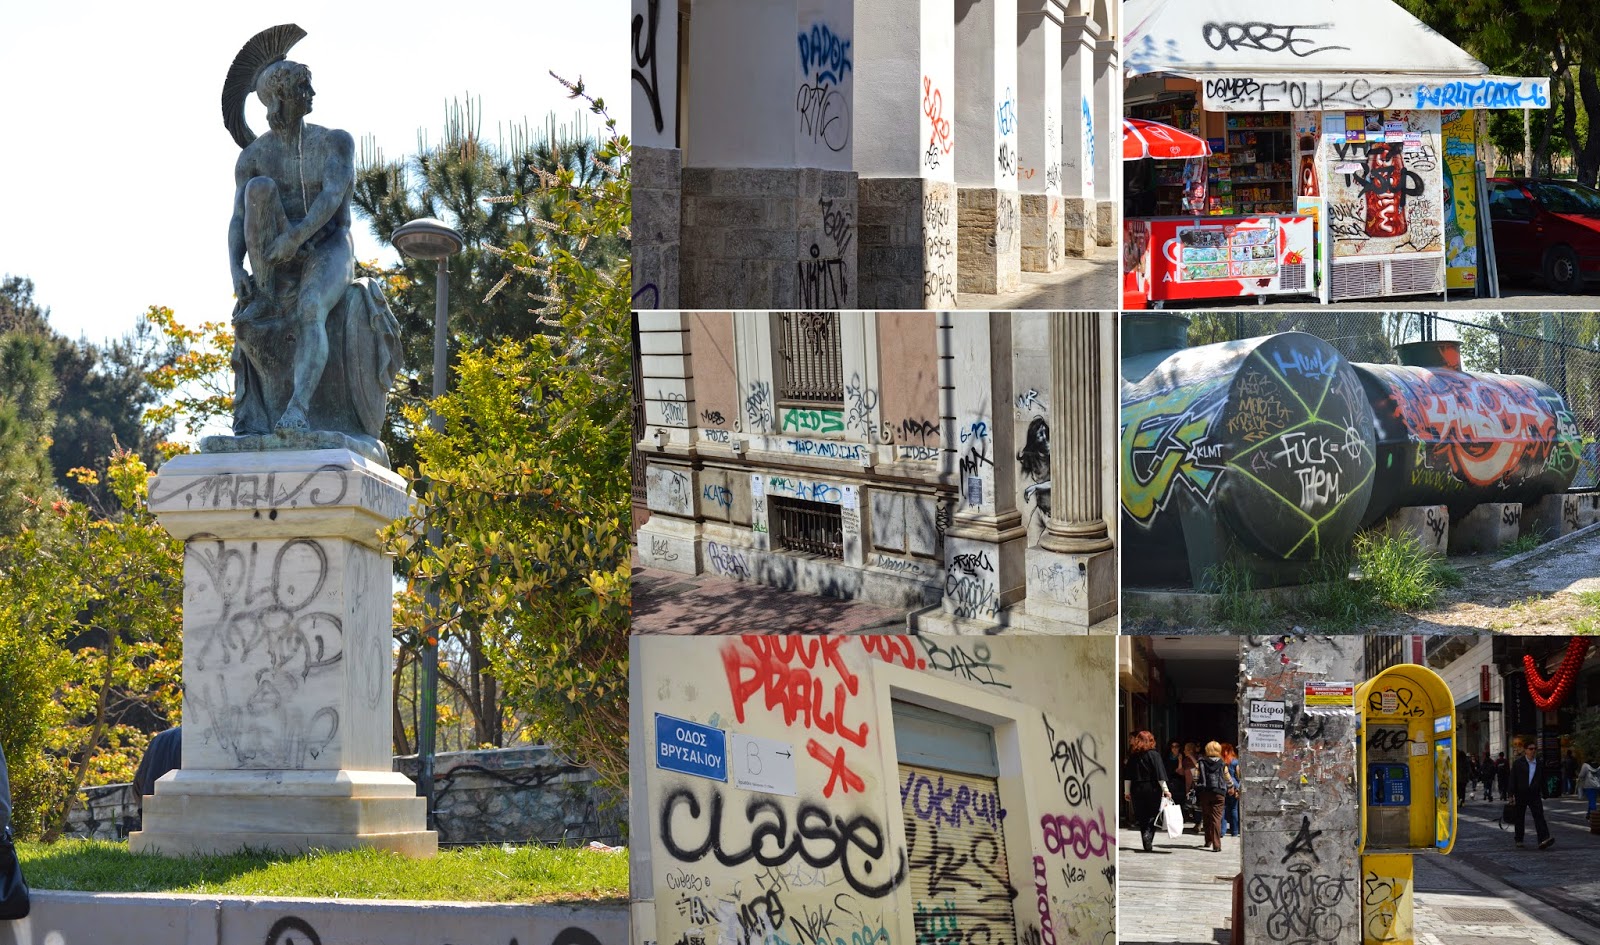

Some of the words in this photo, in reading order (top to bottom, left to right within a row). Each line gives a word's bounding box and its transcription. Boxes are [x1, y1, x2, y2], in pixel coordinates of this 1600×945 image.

[1252, 704, 1284, 715] Βάφω
[676, 727, 707, 747] ΟΔΟΣ
[660, 742, 721, 768] ΒΡΥΣΑΚΙΟΥ
